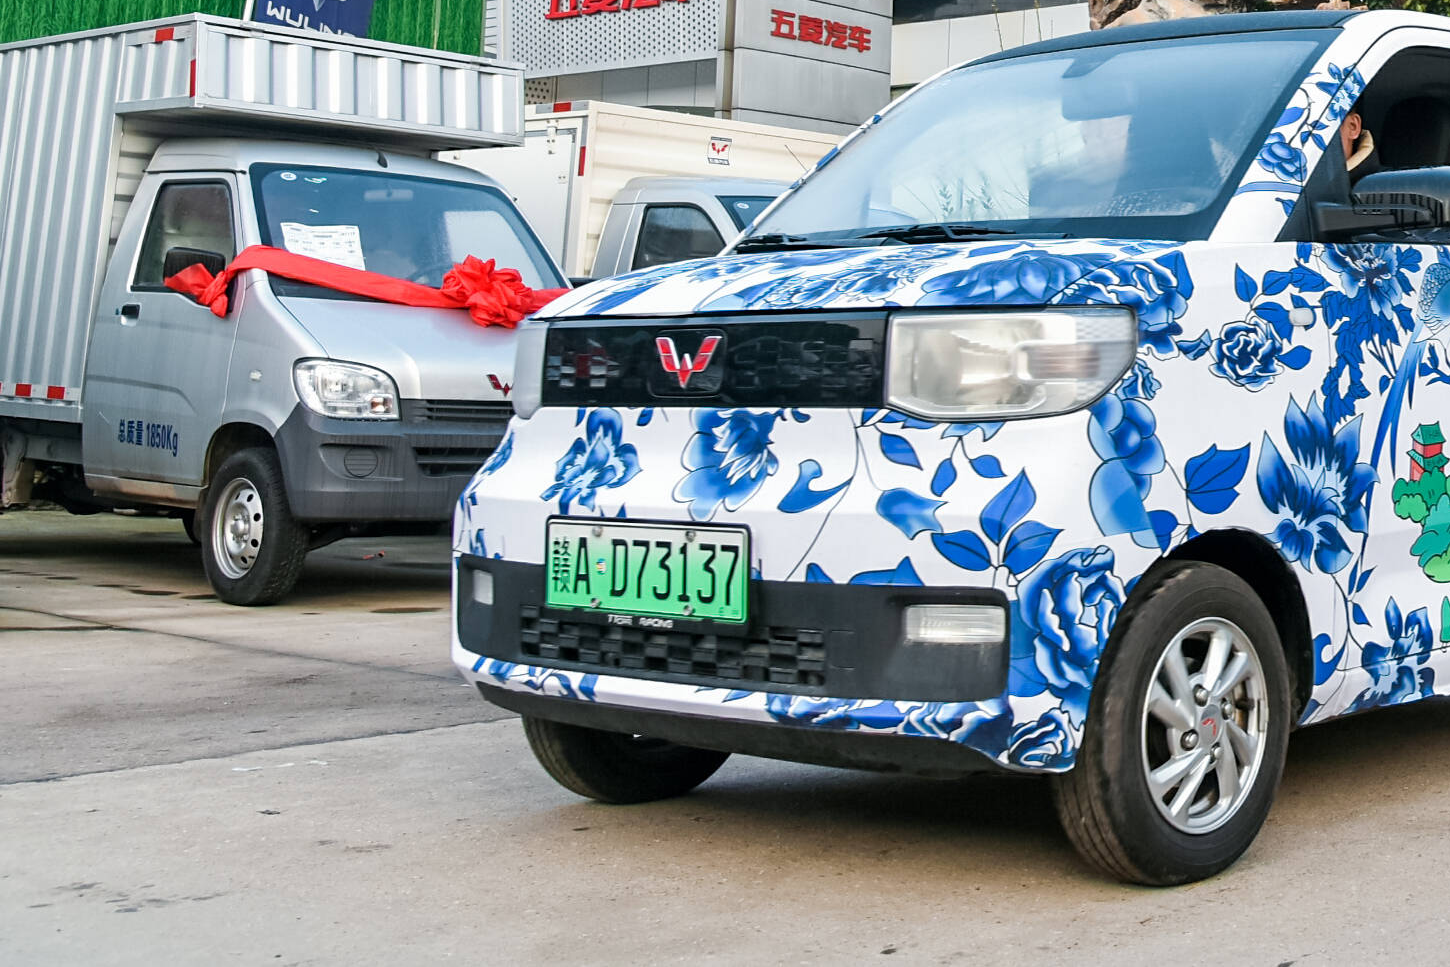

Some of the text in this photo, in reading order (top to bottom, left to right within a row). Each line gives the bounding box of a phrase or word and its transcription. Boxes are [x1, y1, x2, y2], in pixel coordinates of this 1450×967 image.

[770, 9, 871, 53] 五菱汽车
[146, 423, 178, 457] 1850Kg
